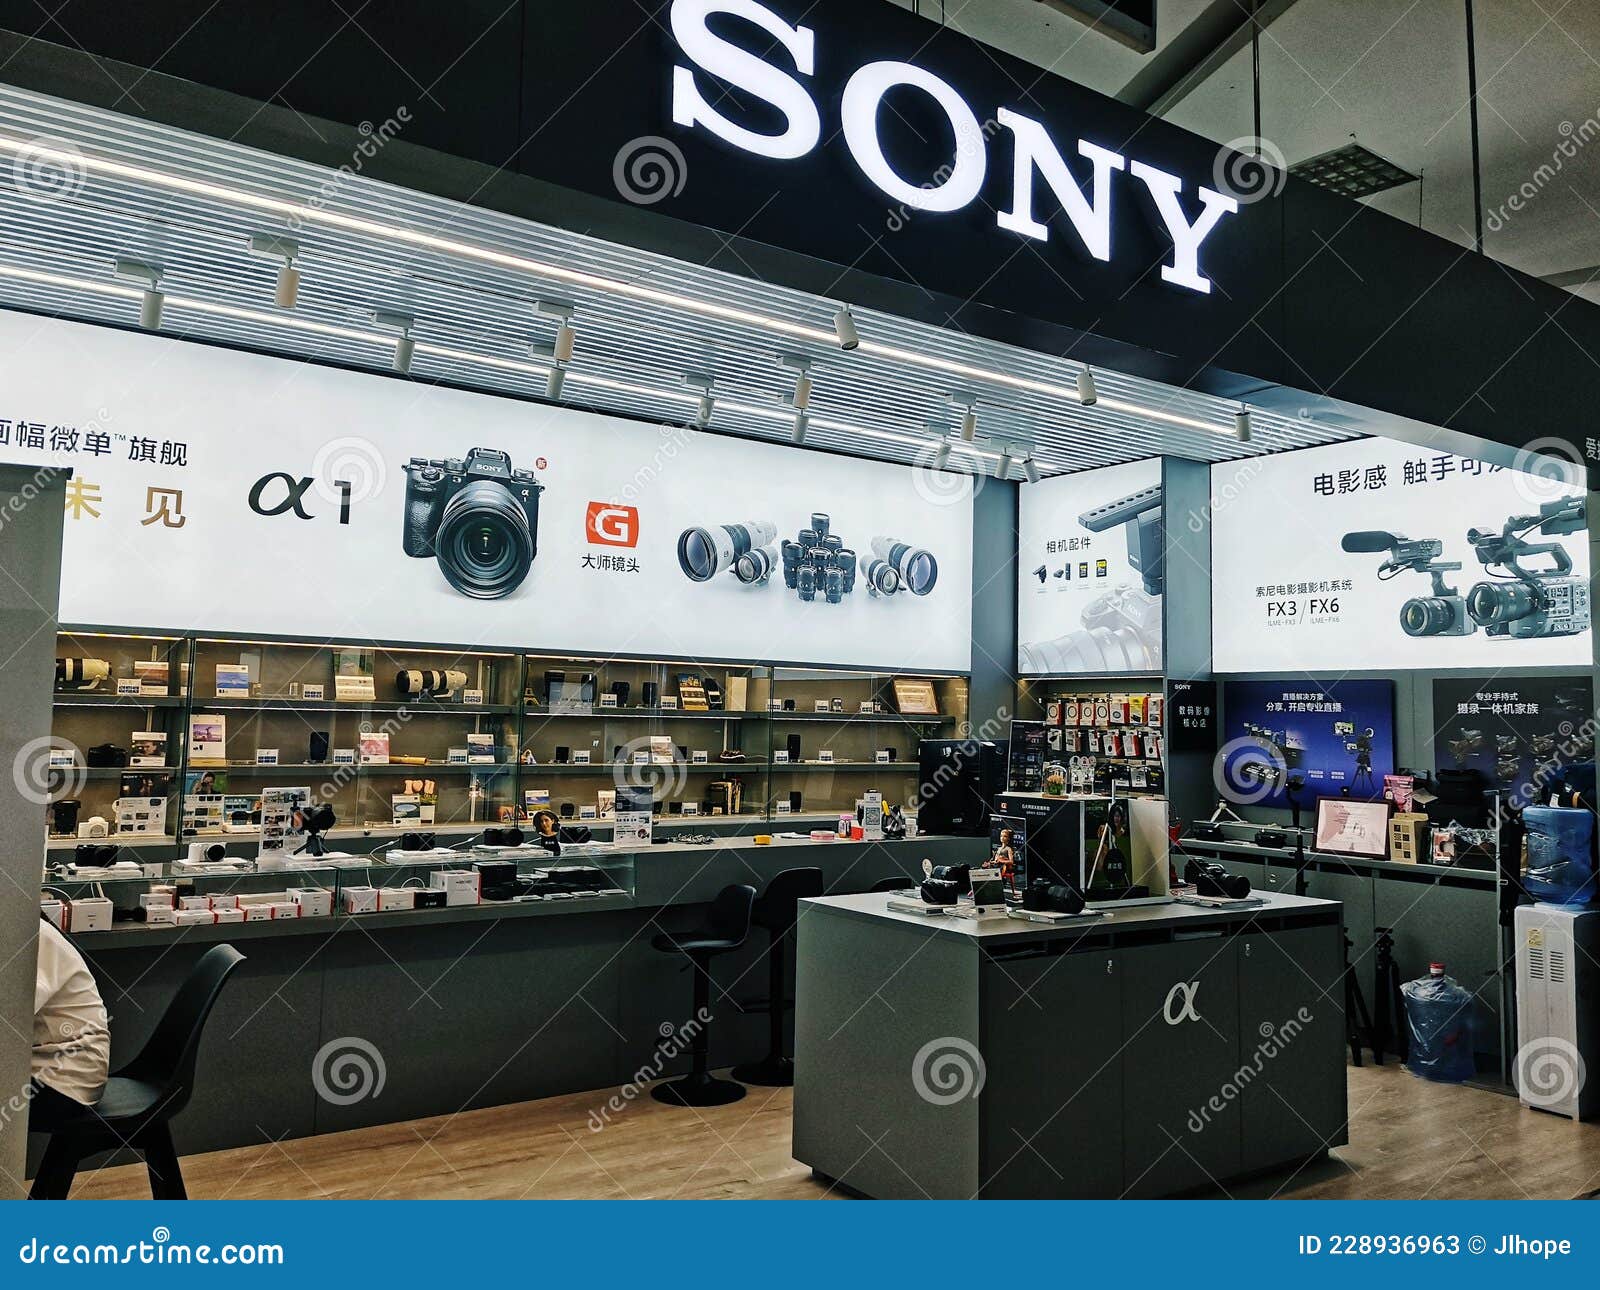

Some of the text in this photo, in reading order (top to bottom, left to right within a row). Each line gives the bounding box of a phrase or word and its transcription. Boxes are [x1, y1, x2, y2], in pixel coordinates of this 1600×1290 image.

[669, 0, 1238, 295] SONY
[476, 464, 503, 473] SONY
[1313, 464, 1387, 496] 电影感
[1046, 537, 1091, 554] 相机配件
[581, 553, 640, 574] 大师镜头
[1255, 579, 1353, 598] 索尼电影摄影机系统
[1267, 598, 1340, 617] FX3 FX6
[1475, 692, 1519, 701] 专业手持式
[1457, 703, 1539, 715] 摄录一体机家族
